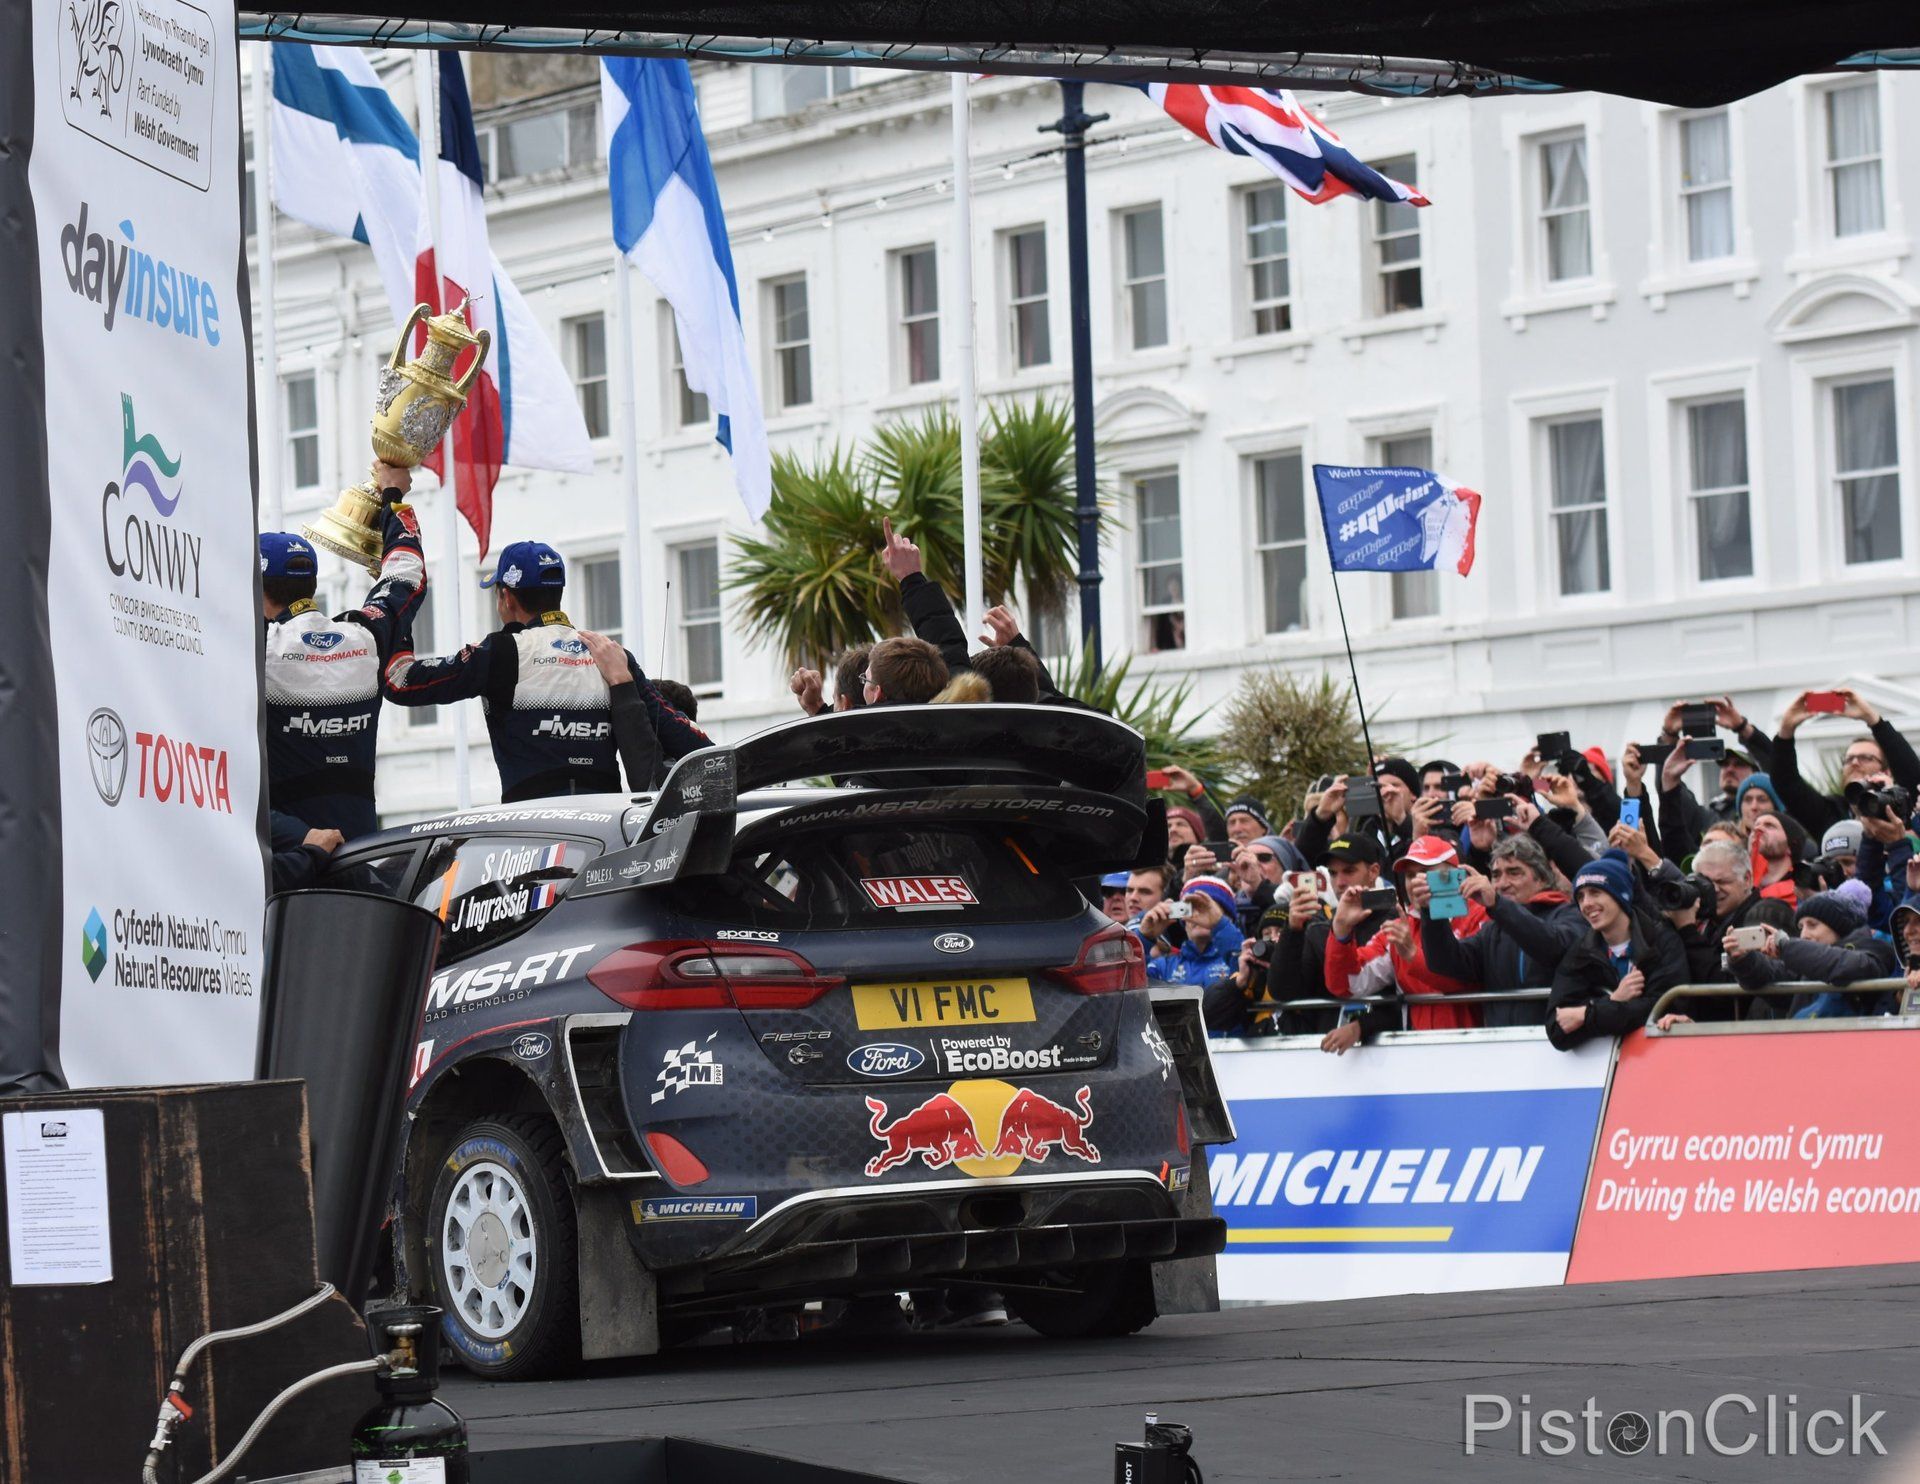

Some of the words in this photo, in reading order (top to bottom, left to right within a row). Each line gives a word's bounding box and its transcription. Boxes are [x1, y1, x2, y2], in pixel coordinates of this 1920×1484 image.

[142, 33, 182, 74] Lywodraeth
[184, 57, 204, 86] Cymru
[199, 37, 209, 58] gan
[137, 77, 150, 104] Part
[151, 85, 174, 117] Funded
[174, 94, 182, 124] by
[134, 110, 156, 142] Welsh
[157, 123, 199, 162] Government
[60, 201, 221, 347] dayinsure
[1328, 468, 1361, 479] World
[1363, 468, 1421, 479] Champions
[109, 593, 139, 617] CYNGOR
[113, 616, 139, 639] COUNTY
[139, 624, 175, 648] BOROUGH
[175, 632, 204, 656] COUNCIL
[309, 633, 334, 648] Ford
[282, 653, 305, 662] FORD
[305, 648, 369, 663] PERFORMANCE
[533, 656, 557, 666] FORD
[302, 713, 372, 735] MS-RT
[135, 731, 232, 814] TOYOTA
[568, 756, 594, 766] sparco
[681, 785, 703, 800] NGK
[410, 808, 613, 834] www.MSPORTSTORE.com
[778, 799, 1115, 828] www.MSPORTSTORE.com
[481, 852, 496, 885] S
[498, 845, 540, 886] Ogier
[586, 868, 614, 884] ENDLESS
[865, 878, 974, 904] WALES
[451, 897, 467, 932] J
[465, 887, 531, 932] Ingrassia
[114, 908, 164, 951] Cyfoeth
[167, 914, 212, 952] Naturiol
[212, 919, 248, 960] Cymru
[716, 930, 780, 942] sparco
[942, 936, 967, 950] Ford
[114, 952, 160, 990] Natural
[160, 956, 221, 994] Resources
[220, 961, 253, 997] Wales
[425, 943, 597, 1012] MS-RT
[425, 1010, 448, 1023] OAD
[454, 989, 533, 1015] TECHNOLOGY
[933, 984, 1000, 1021] FMC
[518, 1036, 545, 1057] Ford
[760, 1030, 833, 1043] Fiesta
[941, 1035, 995, 1050] Powered
[996, 1035, 1012, 1048] by
[860, 1047, 912, 1072] Ford
[944, 1044, 1062, 1073] EcoBoost
[1608, 1127, 1679, 1170] Gyrru
[1683, 1125, 1794, 1161] economi
[1798, 1126, 1883, 1170] Cymru
[1207, 1145, 1546, 1206] MICHELIN
[658, 1202, 746, 1215] MICHELIN
[1595, 1177, 1688, 1221] Driving
[1693, 1177, 1736, 1214] the
[1742, 1177, 1820, 1214] Welsh
